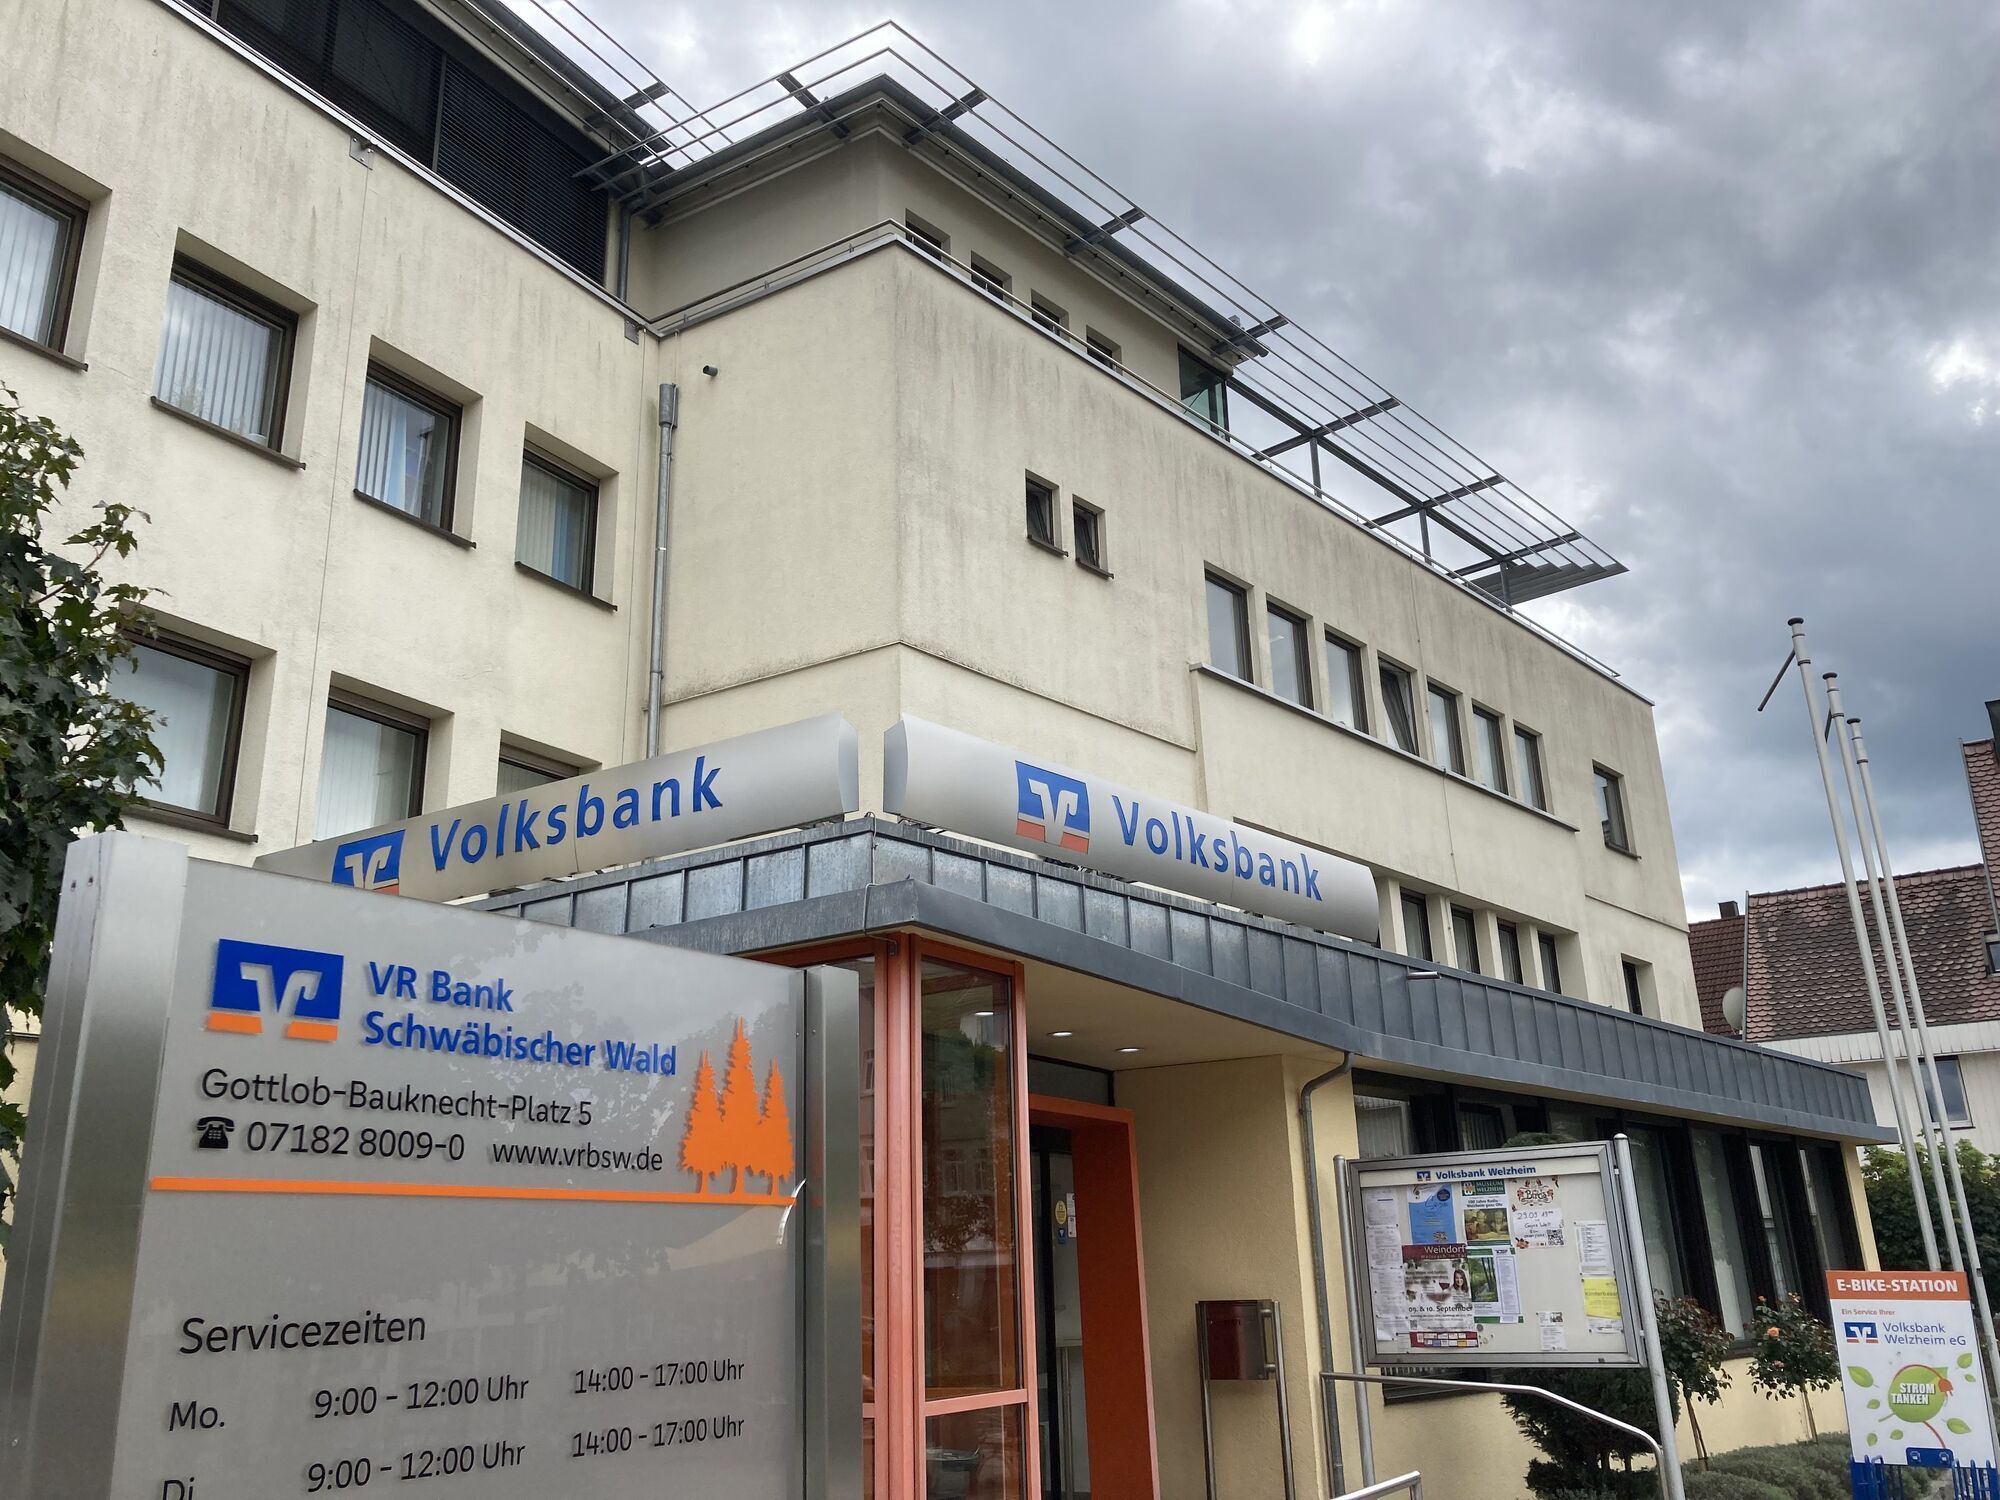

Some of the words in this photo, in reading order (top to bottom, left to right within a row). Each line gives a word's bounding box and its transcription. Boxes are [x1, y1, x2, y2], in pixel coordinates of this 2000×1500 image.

[430, 755, 722, 872] Volksbank
[1112, 795, 1322, 901] Volksbank
[369, 961, 417, 999] VR
[432, 970, 514, 1012] Bank
[365, 1010, 596, 1066] Schwäbischer
[605, 1039, 677, 1075] Wald
[201, 1068, 571, 1124] Gottlob-Bauknecht-Platz
[578, 1101, 592, 1125] 5
[247, 1121, 349, 1155] 07182
[359, 1128, 465, 1160] 8009-0
[493, 1142, 663, 1171] www.vrbsw.de
[1435, 1168, 1486, 1180] Volksbank
[1488, 1165, 1537, 1176] Welzheim
[1424, 1245, 1466, 1254] Weindorf
[1836, 1278, 1959, 1293] E-BIKE-STATION
[1436, 1304, 1473, 1313] September
[1841, 1308, 1852, 1316] Ein
[1853, 1308, 1878, 1316] Service
[1879, 1308, 1896, 1316] Ihrer
[179, 1310, 425, 1354] Servicezeiten
[1882, 1321, 1946, 1334] Volksbank
[1884, 1333, 1946, 1346] Welzheim
[1949, 1335, 1967, 1346] eG
[168, 1401, 225, 1432] Mo.
[314, 1386, 377, 1418] 9:00
[406, 1379, 479, 1410] 12:00
[487, 1374, 529, 1402] Uhr
[574, 1366, 633, 1394] 14:00
[654, 1360, 708, 1387] 17:00
[713, 1358, 745, 1382] Uhr
[1890, 1393, 1930, 1405] TANKEN
[1899, 1382, 1936, 1394] STROM
[308, 1457, 371, 1493] 9:00
[401, 1445, 475, 1481] 12:00
[483, 1440, 526, 1470] Uhr
[572, 1427, 632, 1458] 14:00
[653, 1418, 707, 1447] 17:00
[713, 1414, 745, 1440] Uhr
